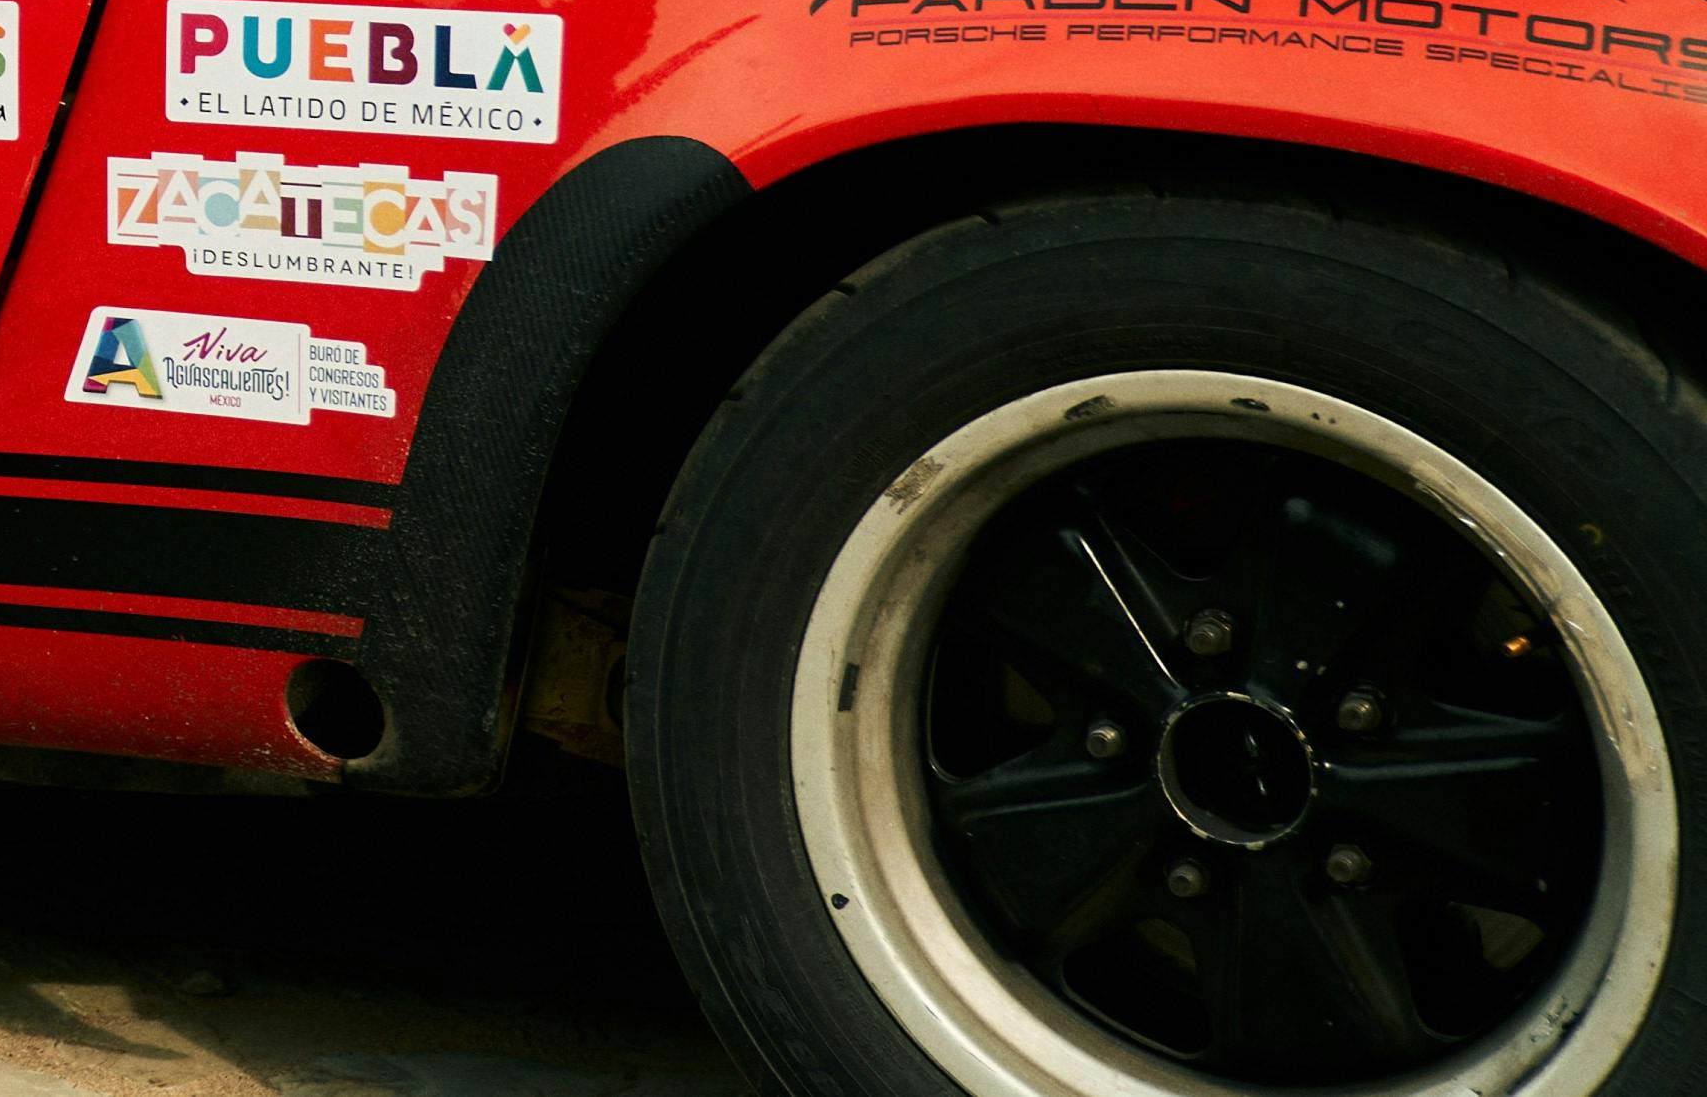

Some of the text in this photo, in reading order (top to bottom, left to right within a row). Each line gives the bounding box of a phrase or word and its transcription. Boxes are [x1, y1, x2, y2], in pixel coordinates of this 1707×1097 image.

[849, 22, 1048, 50] PORSCHE
[1065, 23, 1405, 57] PERFORMANCE
[198, 91, 524, 132] EL LATIDO DE MÉXICO
[116, 168, 487, 256] ZACATECAS
[192, 247, 414, 281] ¡DESLUMBRANTE!
[345, 348, 360, 365] DE
[309, 365, 380, 389] CONGRESOS
[309, 387, 388, 412] Y VISITANTES
